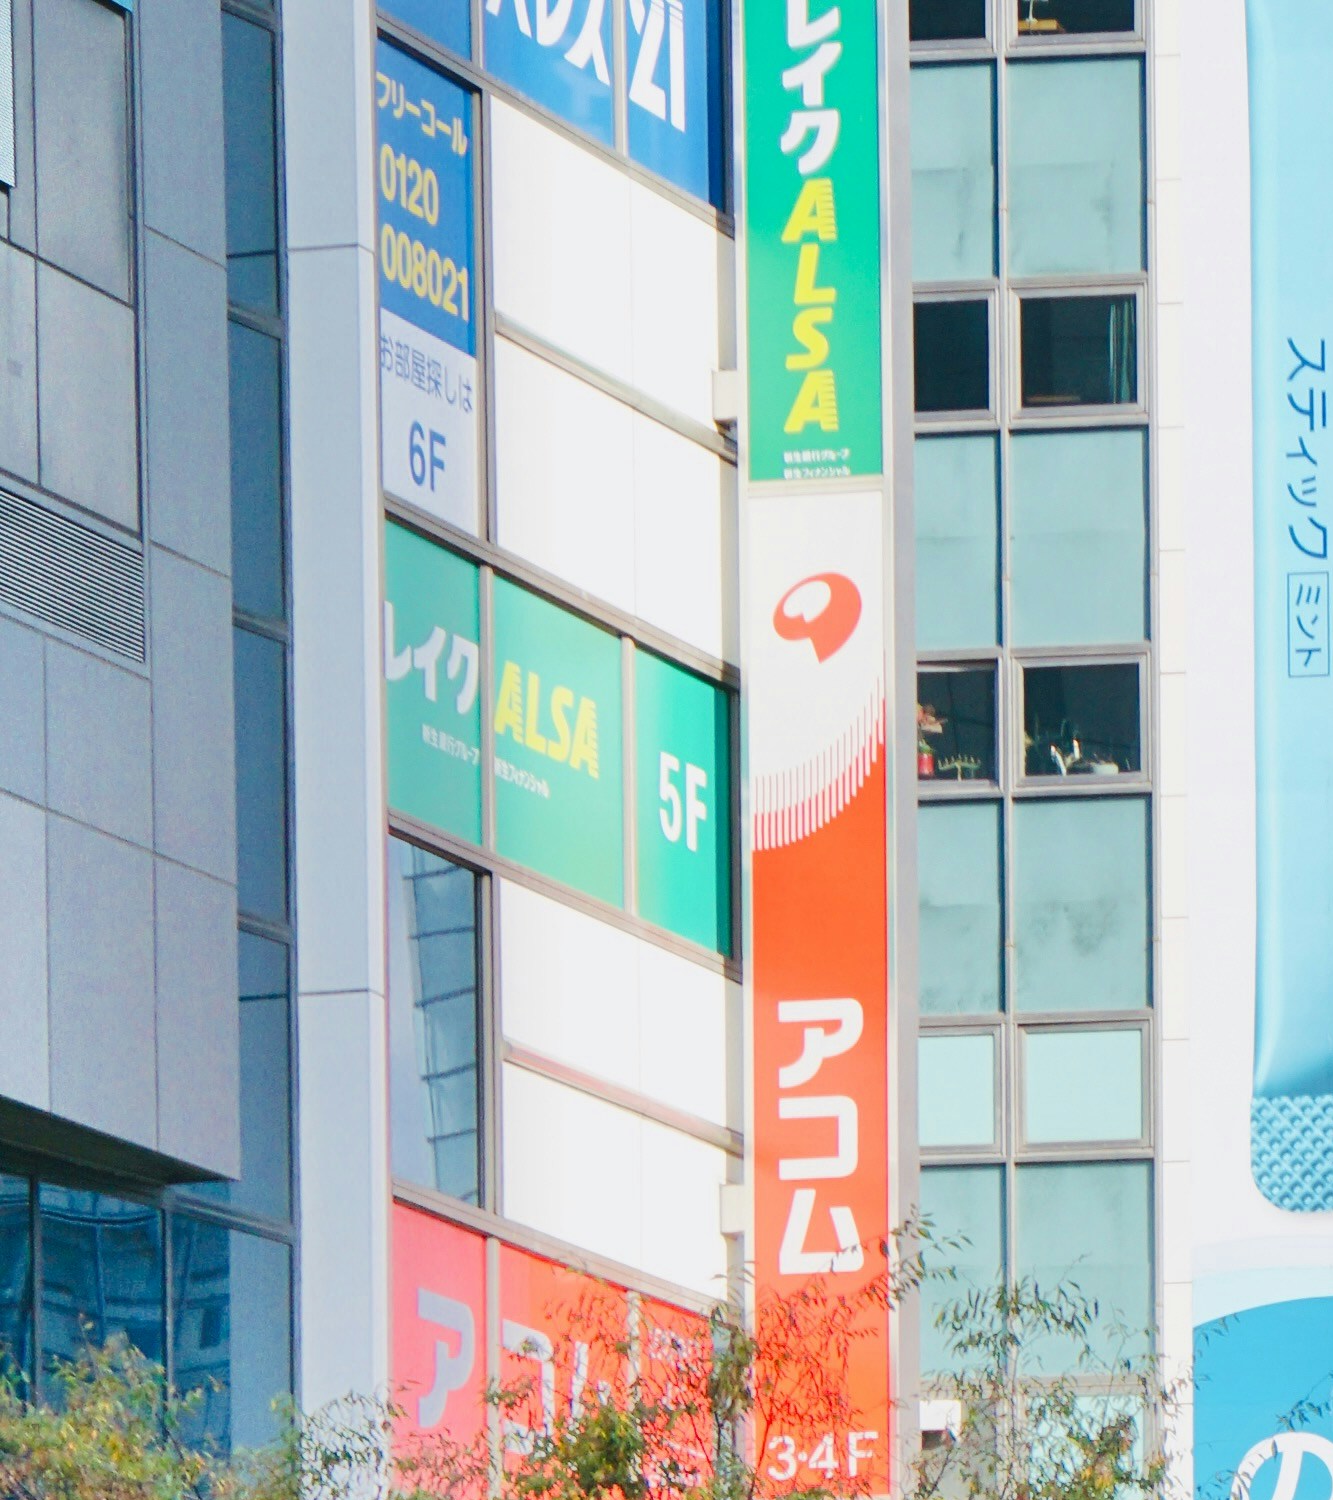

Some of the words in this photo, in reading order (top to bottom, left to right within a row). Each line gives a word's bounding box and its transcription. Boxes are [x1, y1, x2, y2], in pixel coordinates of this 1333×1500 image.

[376, 71, 468, 156] フリーコール
[780, 0, 842, 174] レイク
[380, 144, 439, 226] 0120
[380, 223, 470, 322] 008021
[781, 178, 838, 433] ALSA
[380, 334, 473, 413] お部屋探しは
[409, 420, 447, 493] 6F
[1285, 337, 1328, 560] スティック
[1295, 583, 1323, 668] ミント
[384, 600, 481, 715] レイク
[494, 659, 600, 780] ALSA
[659, 751, 708, 853] 5F
[778, 997, 864, 1275] アコム
